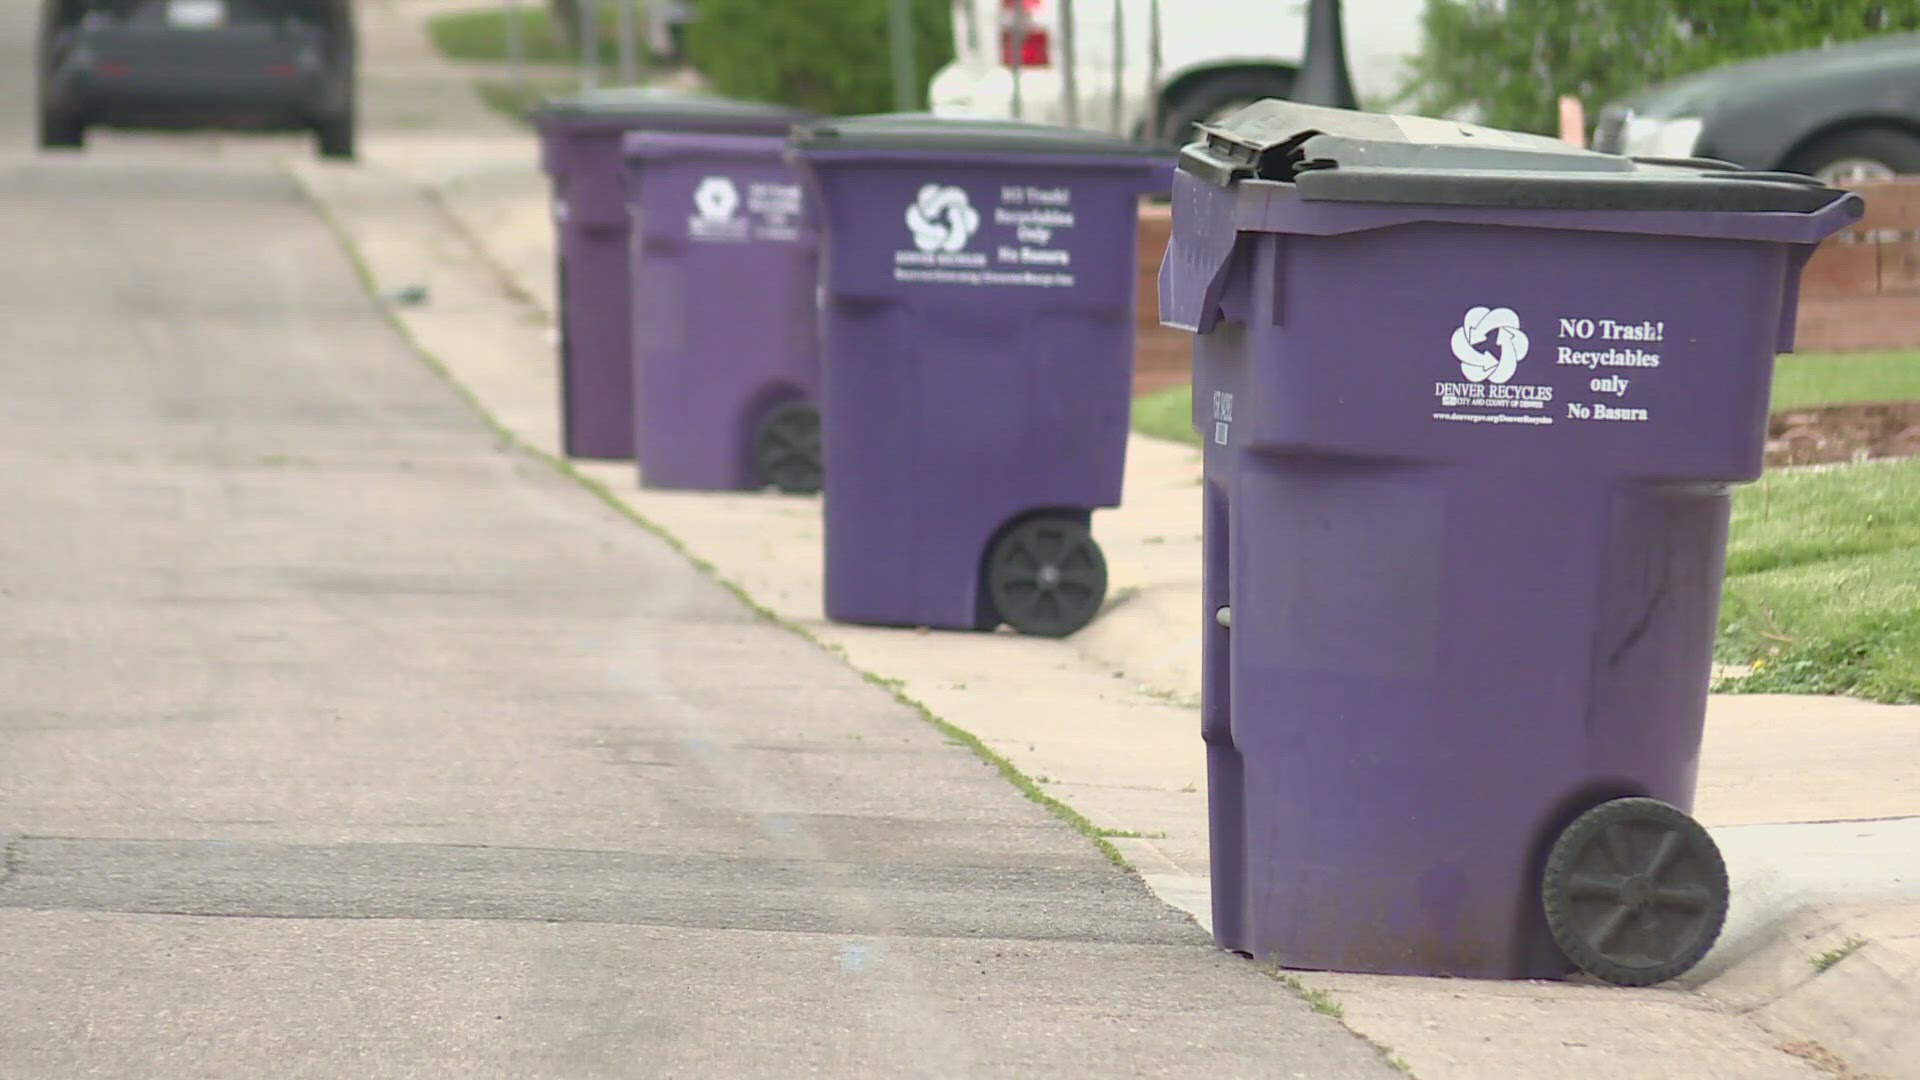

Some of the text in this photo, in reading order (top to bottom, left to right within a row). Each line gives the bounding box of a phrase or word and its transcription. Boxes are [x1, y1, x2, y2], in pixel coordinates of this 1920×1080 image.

[1559, 319, 1664, 341] NO Trash!
[1557, 346, 1660, 369] Recyclables
[1435, 382, 1553, 401] DENVER RECYCLES
[1590, 375, 1629, 396] only
[1457, 397, 1471, 406] CITY
[1471, 398, 1485, 406] AND
[1485, 398, 1510, 407] COUNTY
[1567, 402, 1648, 421] No Basura
